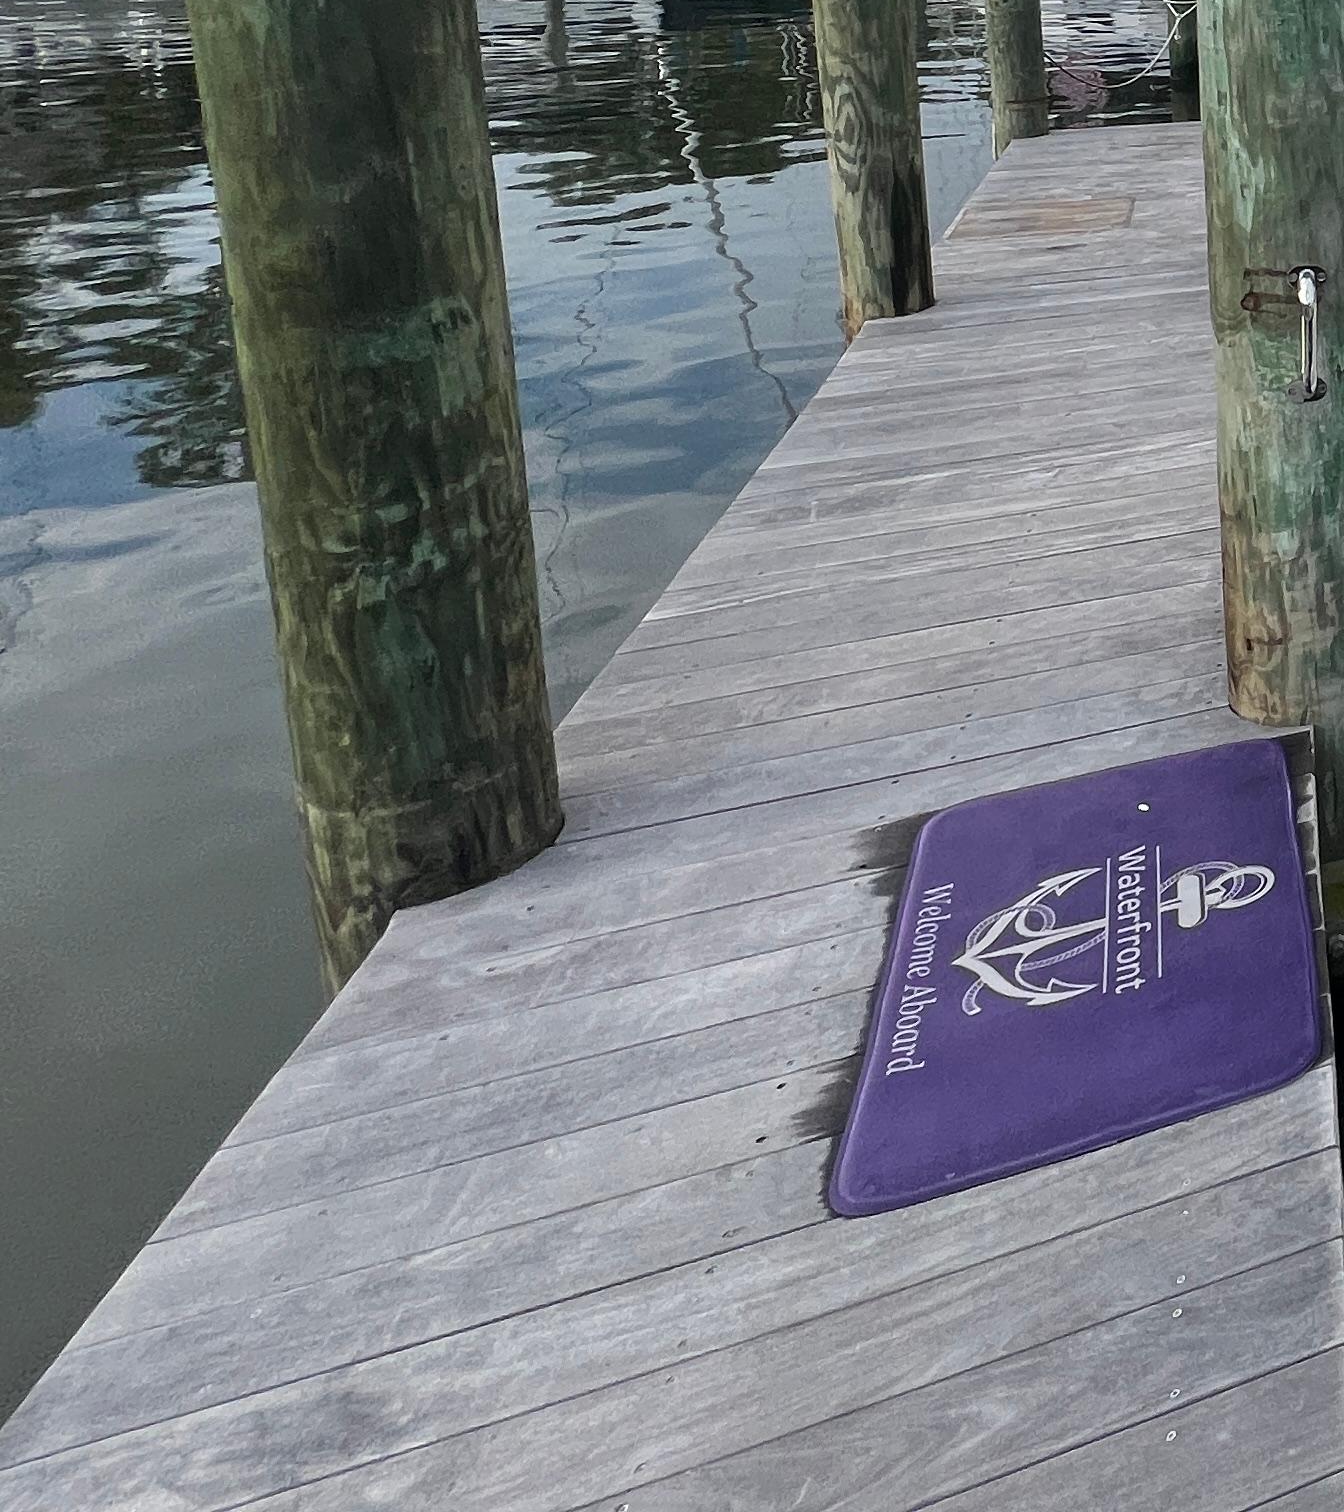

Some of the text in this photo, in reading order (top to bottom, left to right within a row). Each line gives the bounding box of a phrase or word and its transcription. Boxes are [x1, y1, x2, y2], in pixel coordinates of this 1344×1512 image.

[885, 882, 955, 1076] Welcome Aboard
[1115, 845, 1152, 995] Waterfront
